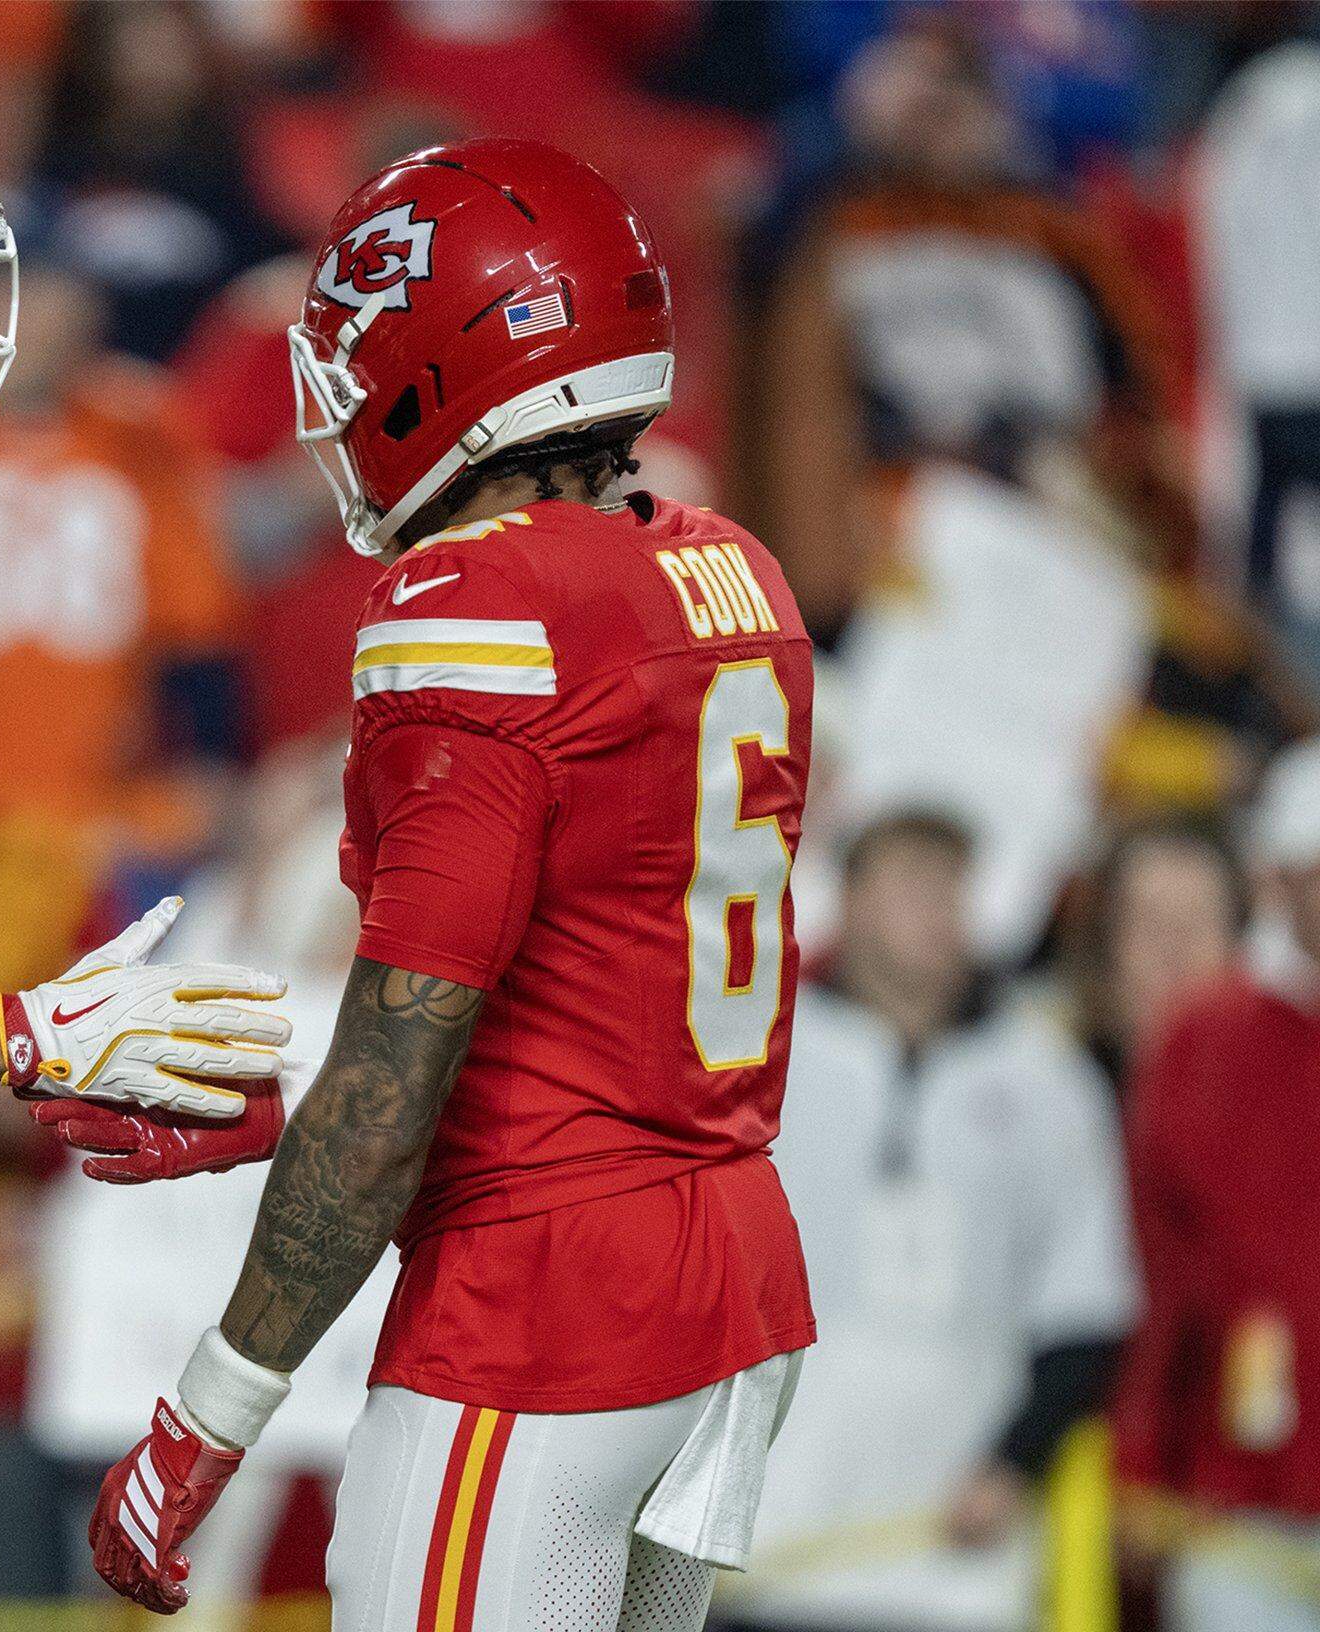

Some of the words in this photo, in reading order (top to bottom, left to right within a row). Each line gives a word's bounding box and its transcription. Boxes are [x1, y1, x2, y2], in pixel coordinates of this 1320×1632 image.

[334, 228, 413, 294] KC
[655, 543, 779, 639] COOK
[684, 657, 792, 1072] 6
